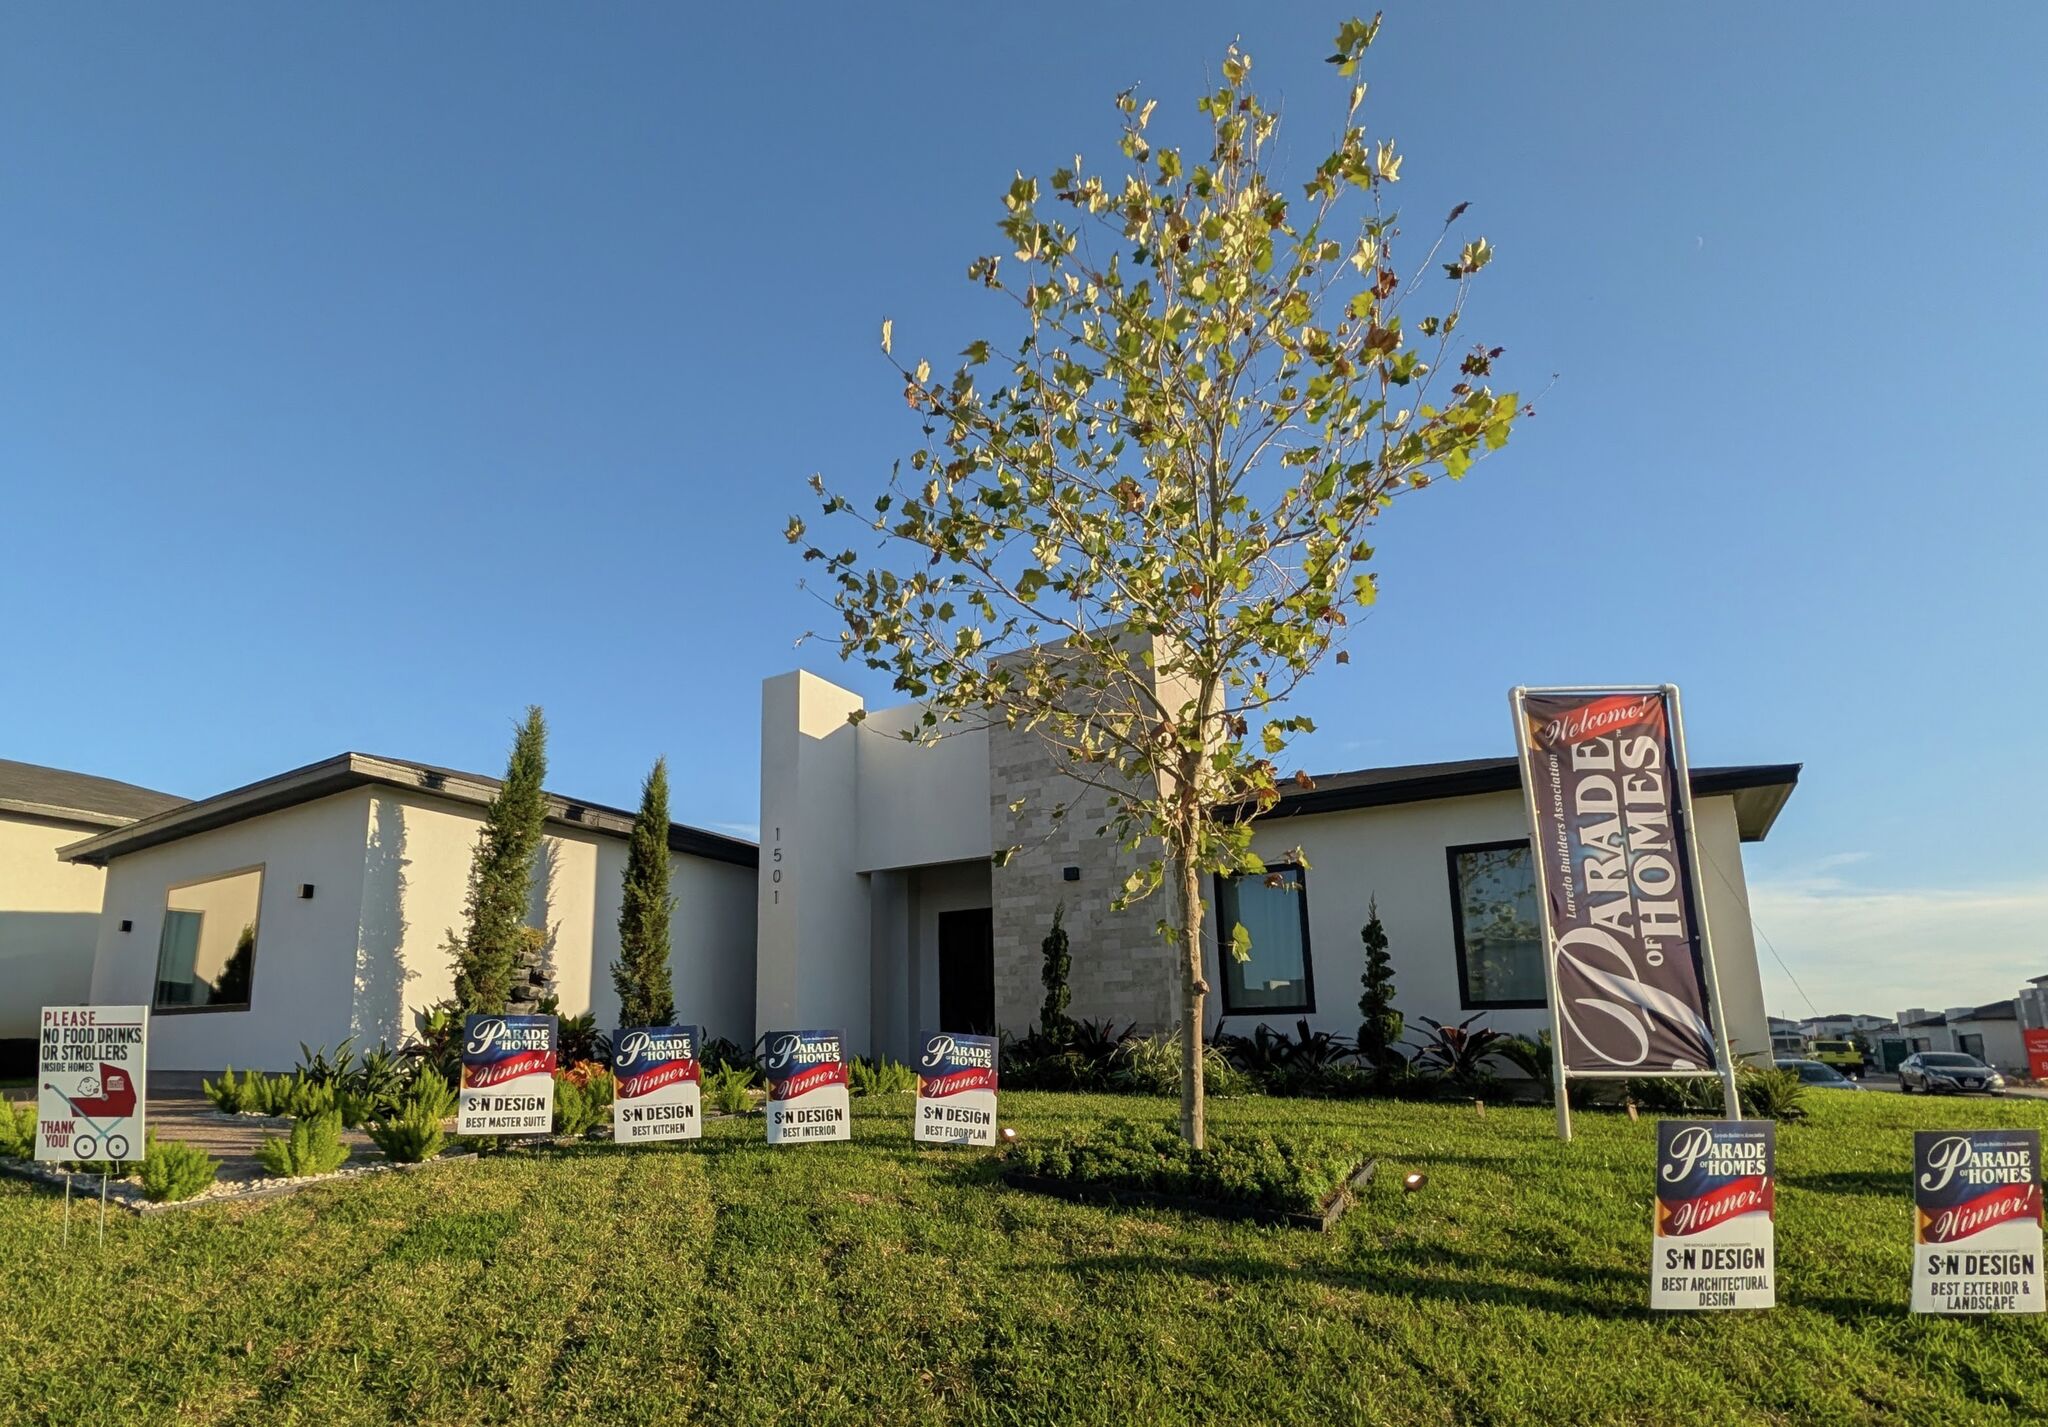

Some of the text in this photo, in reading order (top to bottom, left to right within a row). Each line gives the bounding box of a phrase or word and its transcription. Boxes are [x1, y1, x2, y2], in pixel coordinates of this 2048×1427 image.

[1545, 696, 1647, 746] Welcome!
[1549, 753, 1577, 919] Laredo Builders Association
[1619, 735, 1684, 967] OF HOMES
[773, 827, 782, 905] 1501
[1555, 736, 1715, 1069] PARADE
[44, 1012, 96, 1026] PLEASE
[42, 1028, 143, 1044] NO FOOD, DRINKS,
[467, 1019, 550, 1054] PARADE
[42, 1045, 127, 1060] OR STROLLERS
[502, 1040, 549, 1050] HOMES
[616, 1032, 691, 1067] PARADE
[769, 1035, 840, 1069] PARADE
[922, 1036, 991, 1066] PARADE
[647, 1049, 692, 1061] HOMES
[799, 1053, 840, 1063] HOMES
[951, 1057, 991, 1068] HOMES
[41, 1062, 94, 1072] INSIDE HOMES
[475, 1051, 550, 1087] Winner!
[626, 1059, 693, 1097] Winner!
[778, 1062, 842, 1099] Winner!
[929, 1069, 992, 1097] Winner!
[468, 1098, 545, 1111] S+N DESIGN
[623, 1105, 693, 1122] S+N DESIGN
[774, 1109, 842, 1124] S+N DESIGN
[924, 1107, 990, 1125] S+N DESIGN
[41, 1121, 75, 1133] THANK
[466, 1116, 546, 1128] BEST MASTER SUITE
[632, 1124, 685, 1136] BEST KITCHEN
[783, 1125, 836, 1137] BEST INTERIOR
[925, 1125, 986, 1139] BEST FLOORPLAN
[45, 1135, 69, 1148] YOU!
[1662, 1127, 1765, 1183] PARADE
[1708, 1160, 1766, 1175] HOMES
[1921, 1137, 2031, 1191] PARADE
[1960, 1168, 2031, 1184] OF HOMES
[1674, 1177, 1767, 1234] Winner!
[1935, 1184, 2034, 1242] Winner!
[1666, 1248, 1764, 1269] S+N DESIGN
[1928, 1255, 2034, 1275] S+N DESIGN
[1662, 1276, 1768, 1291] BEST ARCHITECTURAL
[1931, 1281, 2030, 1296] BEST EXTERIOR &
[1699, 1293, 1735, 1306] DESIGN
[1947, 1297, 2015, 1310] LANDSCAPE
